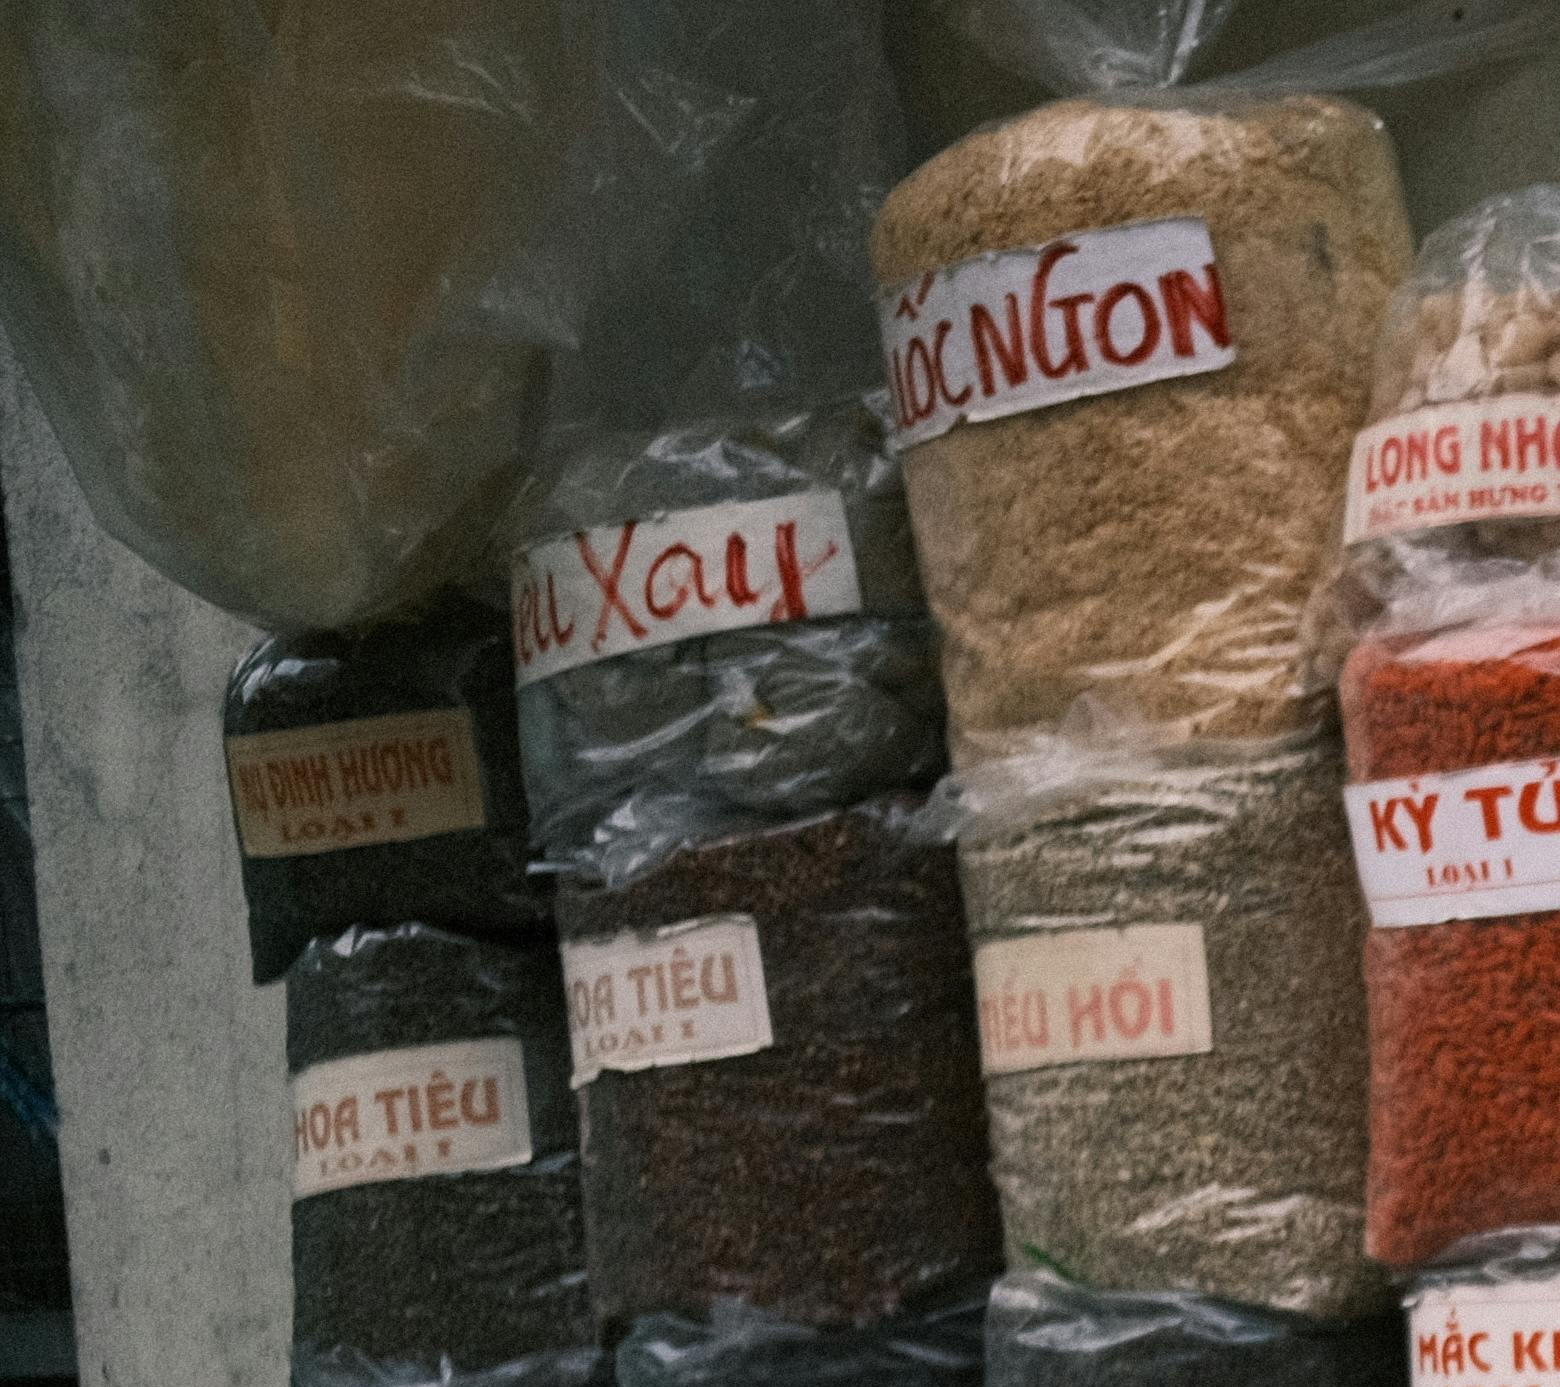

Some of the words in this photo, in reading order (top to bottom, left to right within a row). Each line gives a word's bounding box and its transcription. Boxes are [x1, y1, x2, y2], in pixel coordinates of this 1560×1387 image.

[973, 244, 1234, 396] NGON
[1365, 424, 1461, 494] LONG
[575, 519, 840, 654] Xay
[1426, 862, 1496, 891] LOẠI
[568, 973, 616, 1028] OA
[628, 945, 739, 1018] TIÊU
[374, 1068, 501, 1137] TIÊU
